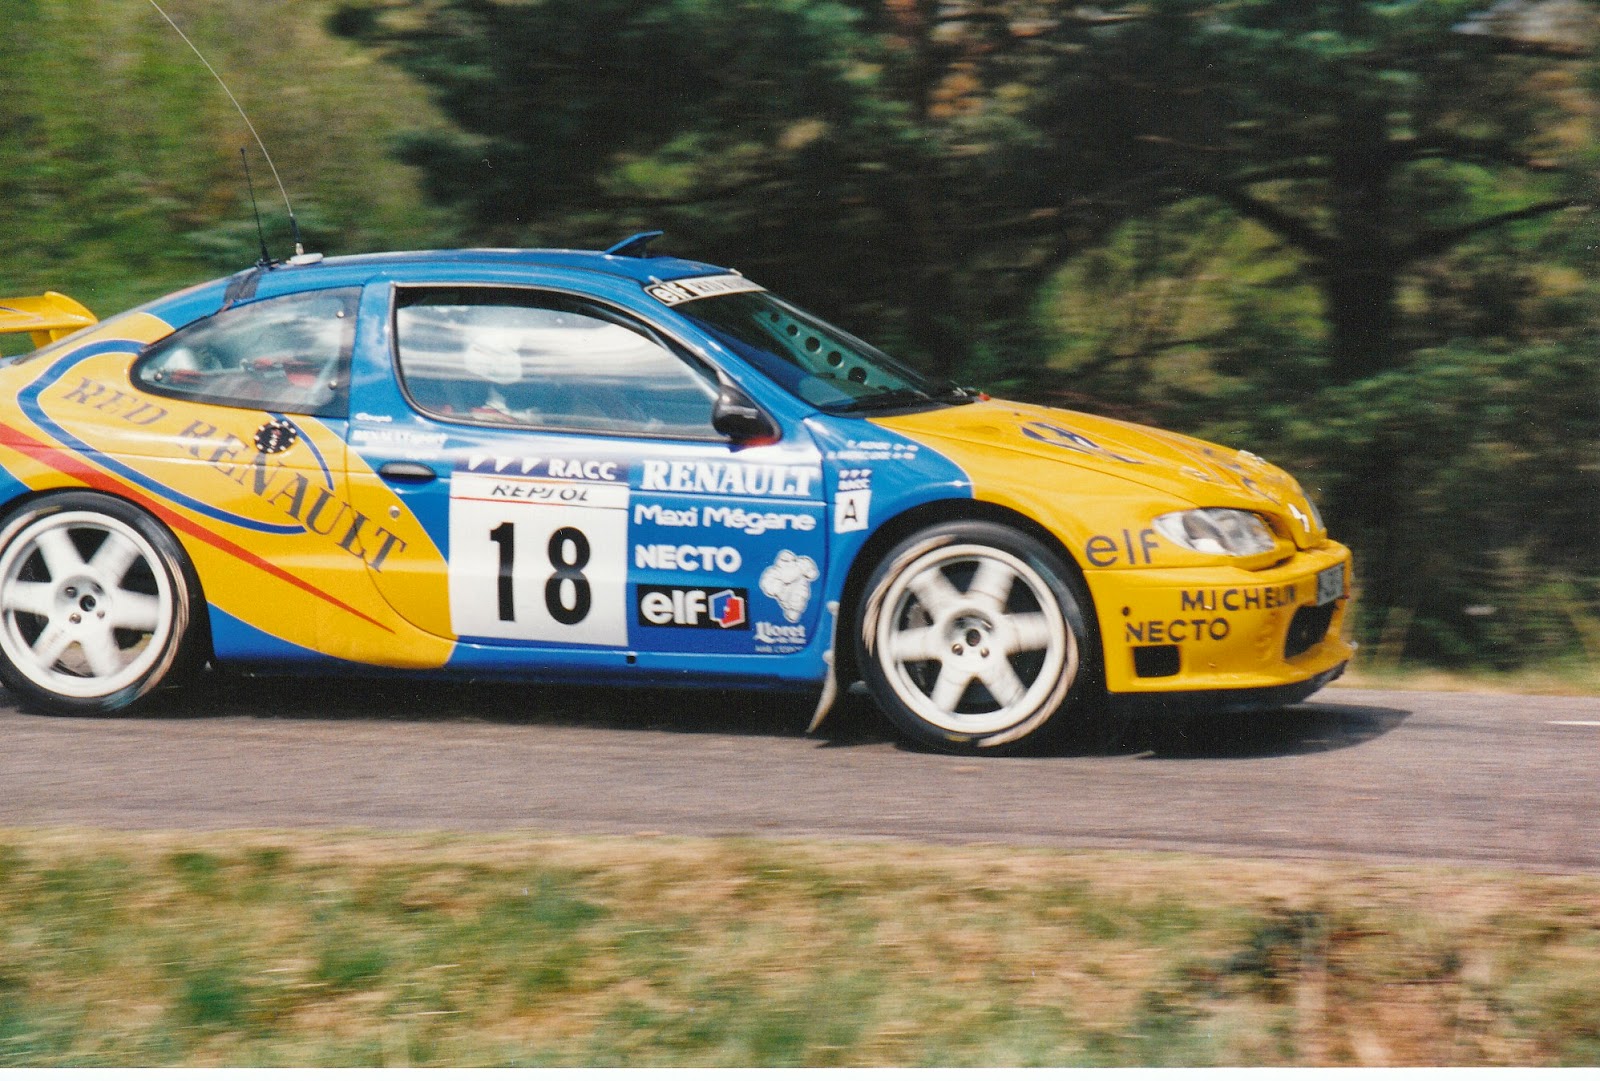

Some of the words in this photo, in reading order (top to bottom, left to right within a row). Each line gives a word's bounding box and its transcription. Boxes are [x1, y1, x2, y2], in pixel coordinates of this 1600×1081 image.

[62, 377, 168, 425] RED
[176, 420, 407, 573] RENAULT
[547, 459, 618, 480] RACC
[640, 460, 819, 497] RENAULT
[634, 504, 698, 528] Maxi
[702, 505, 817, 535] Mégane
[843, 498, 858, 523] A
[635, 544, 742, 573] NECTO
[1086, 529, 1160, 567] elf
[490, 521, 592, 626] 18
[640, 589, 706, 625] elf
[1125, 617, 1230, 643] NECTO
